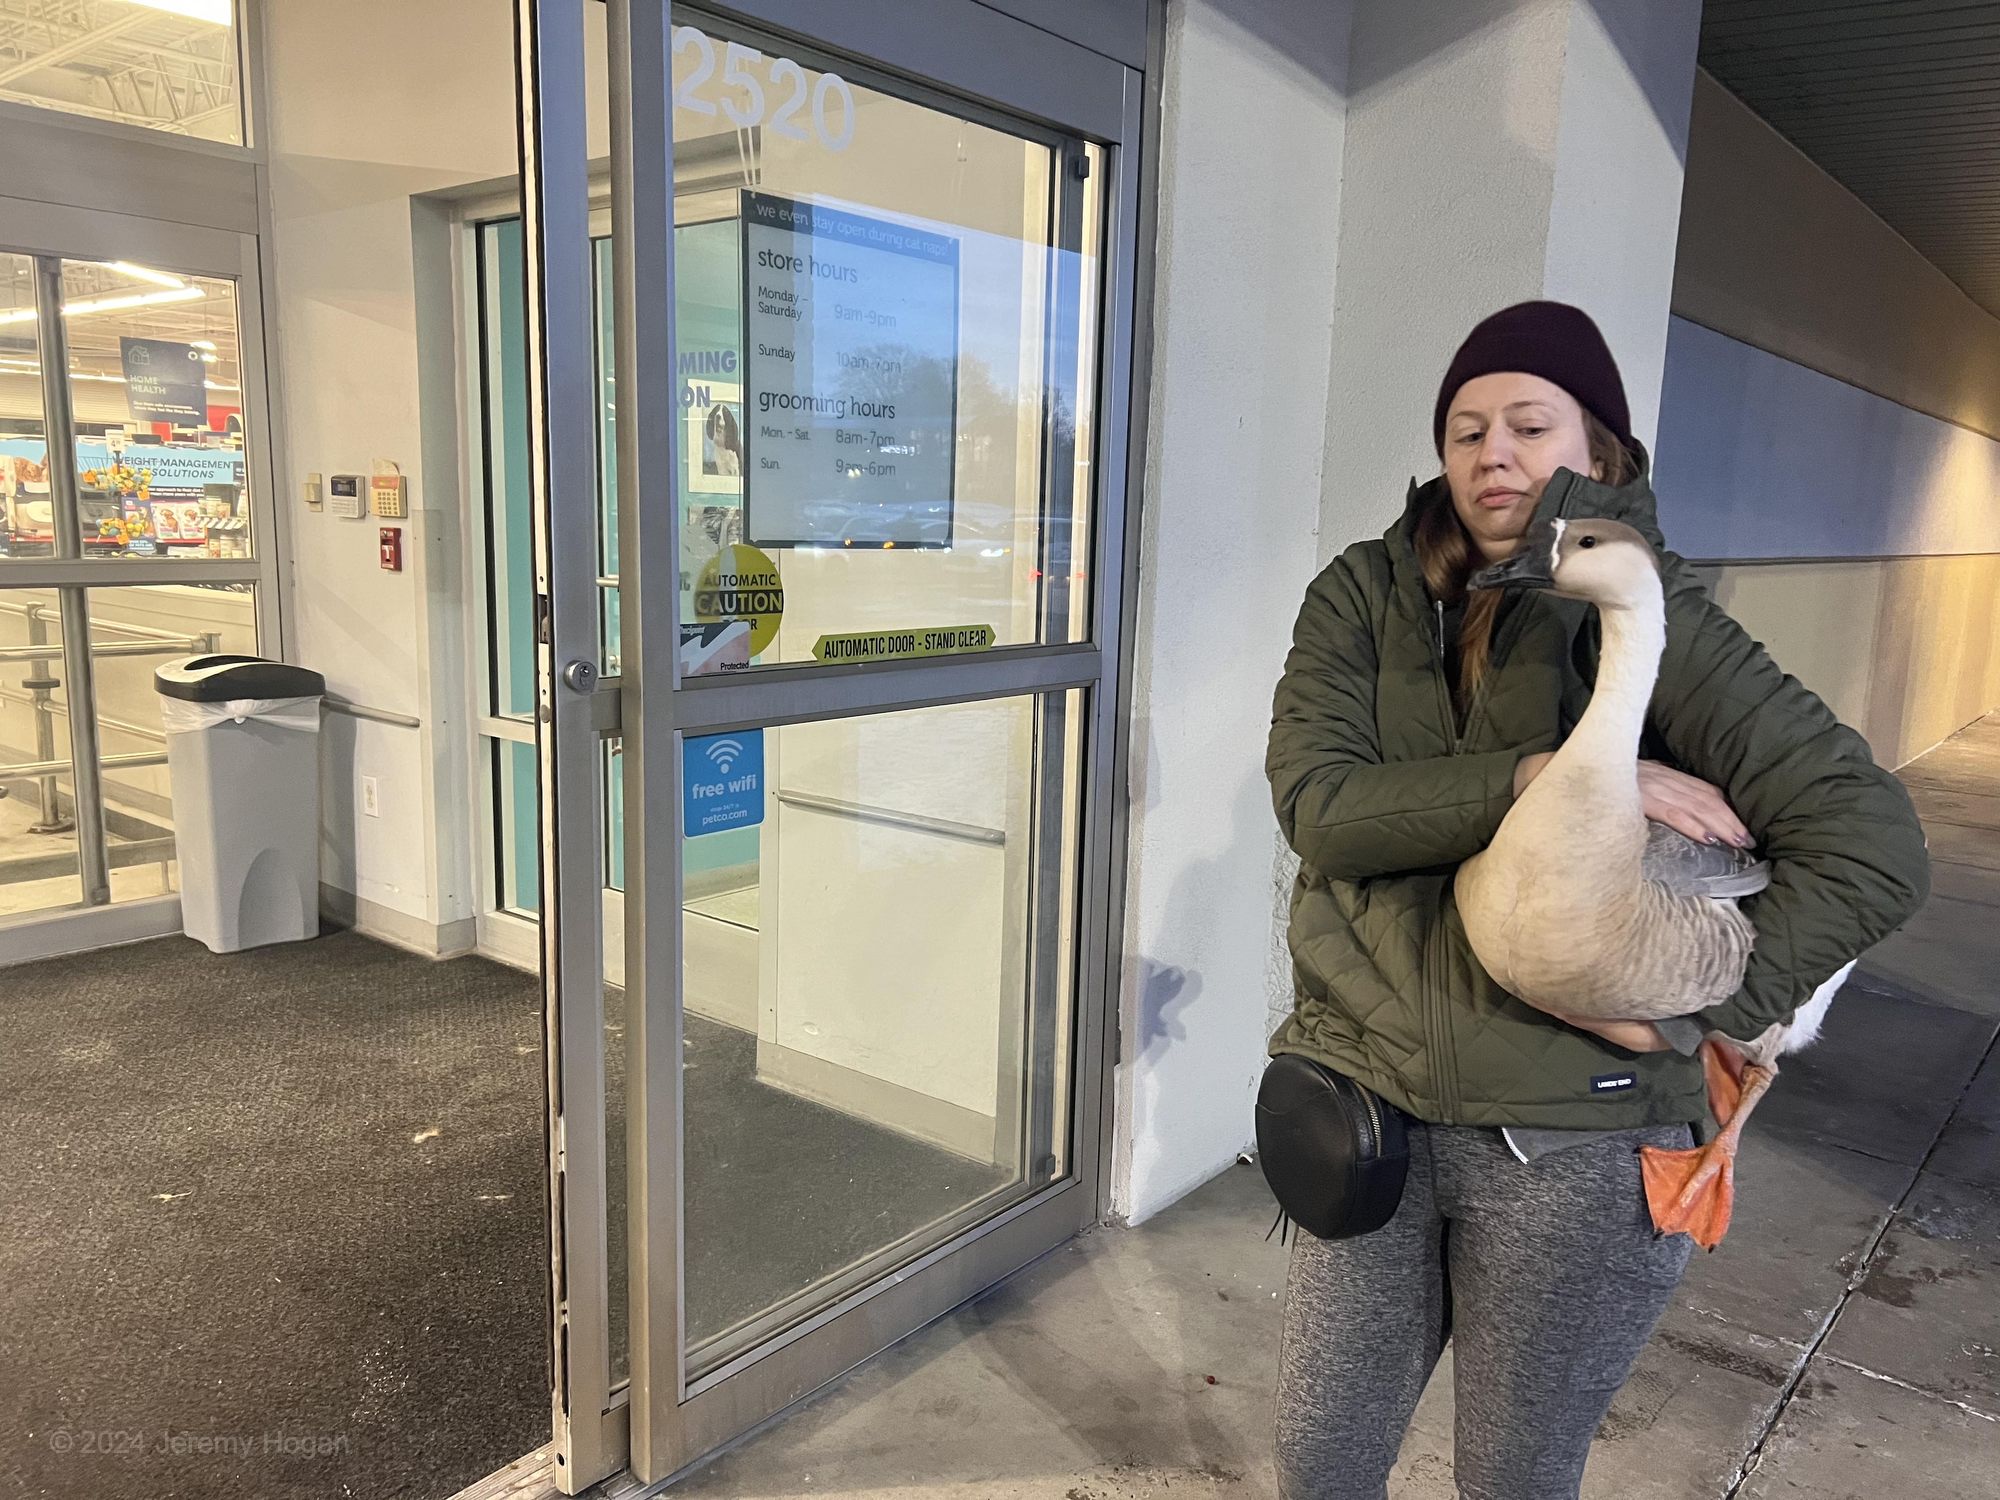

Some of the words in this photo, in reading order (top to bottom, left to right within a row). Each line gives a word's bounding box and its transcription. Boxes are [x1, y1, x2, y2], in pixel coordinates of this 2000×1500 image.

[671, 26, 855, 151] 2520
[756, 204, 776, 218] we
[779, 208, 809, 226] even
[811, 215, 835, 234] stay
[837, 222, 866, 239] open
[868, 226, 903, 250] during
[758, 249, 803, 273] store
[809, 255, 858, 284] hours
[758, 285, 799, 306] Monday
[758, 302, 802, 321] Saturday
[834, 304, 897, 329] 9am-9pm
[758, 343, 795, 362] Sunday
[129, 374, 158, 385] HOME
[131, 384, 166, 395] HEALTH
[676, 385, 711, 409] ON
[759, 391, 846, 419] grooming
[850, 395, 896, 420] hours
[836, 429, 895, 448] 8am-7pm
[112, 455, 158, 467] WEIGHT
[836, 458, 896, 477] 9am-6pm
[704, 573, 776, 587] AUTOMATIC
[696, 592, 782, 614] CAUTION
[824, 637, 885, 658] AUTOMATIC
[888, 635, 915, 653] DOOR
[925, 632, 955, 650] STAND
[958, 629, 986, 647] CLEAR
[720, 660, 750, 671] Protected
[692, 783, 725, 800] free
[728, 774, 757, 793] wifi
[702, 809, 748, 827] petco.com
